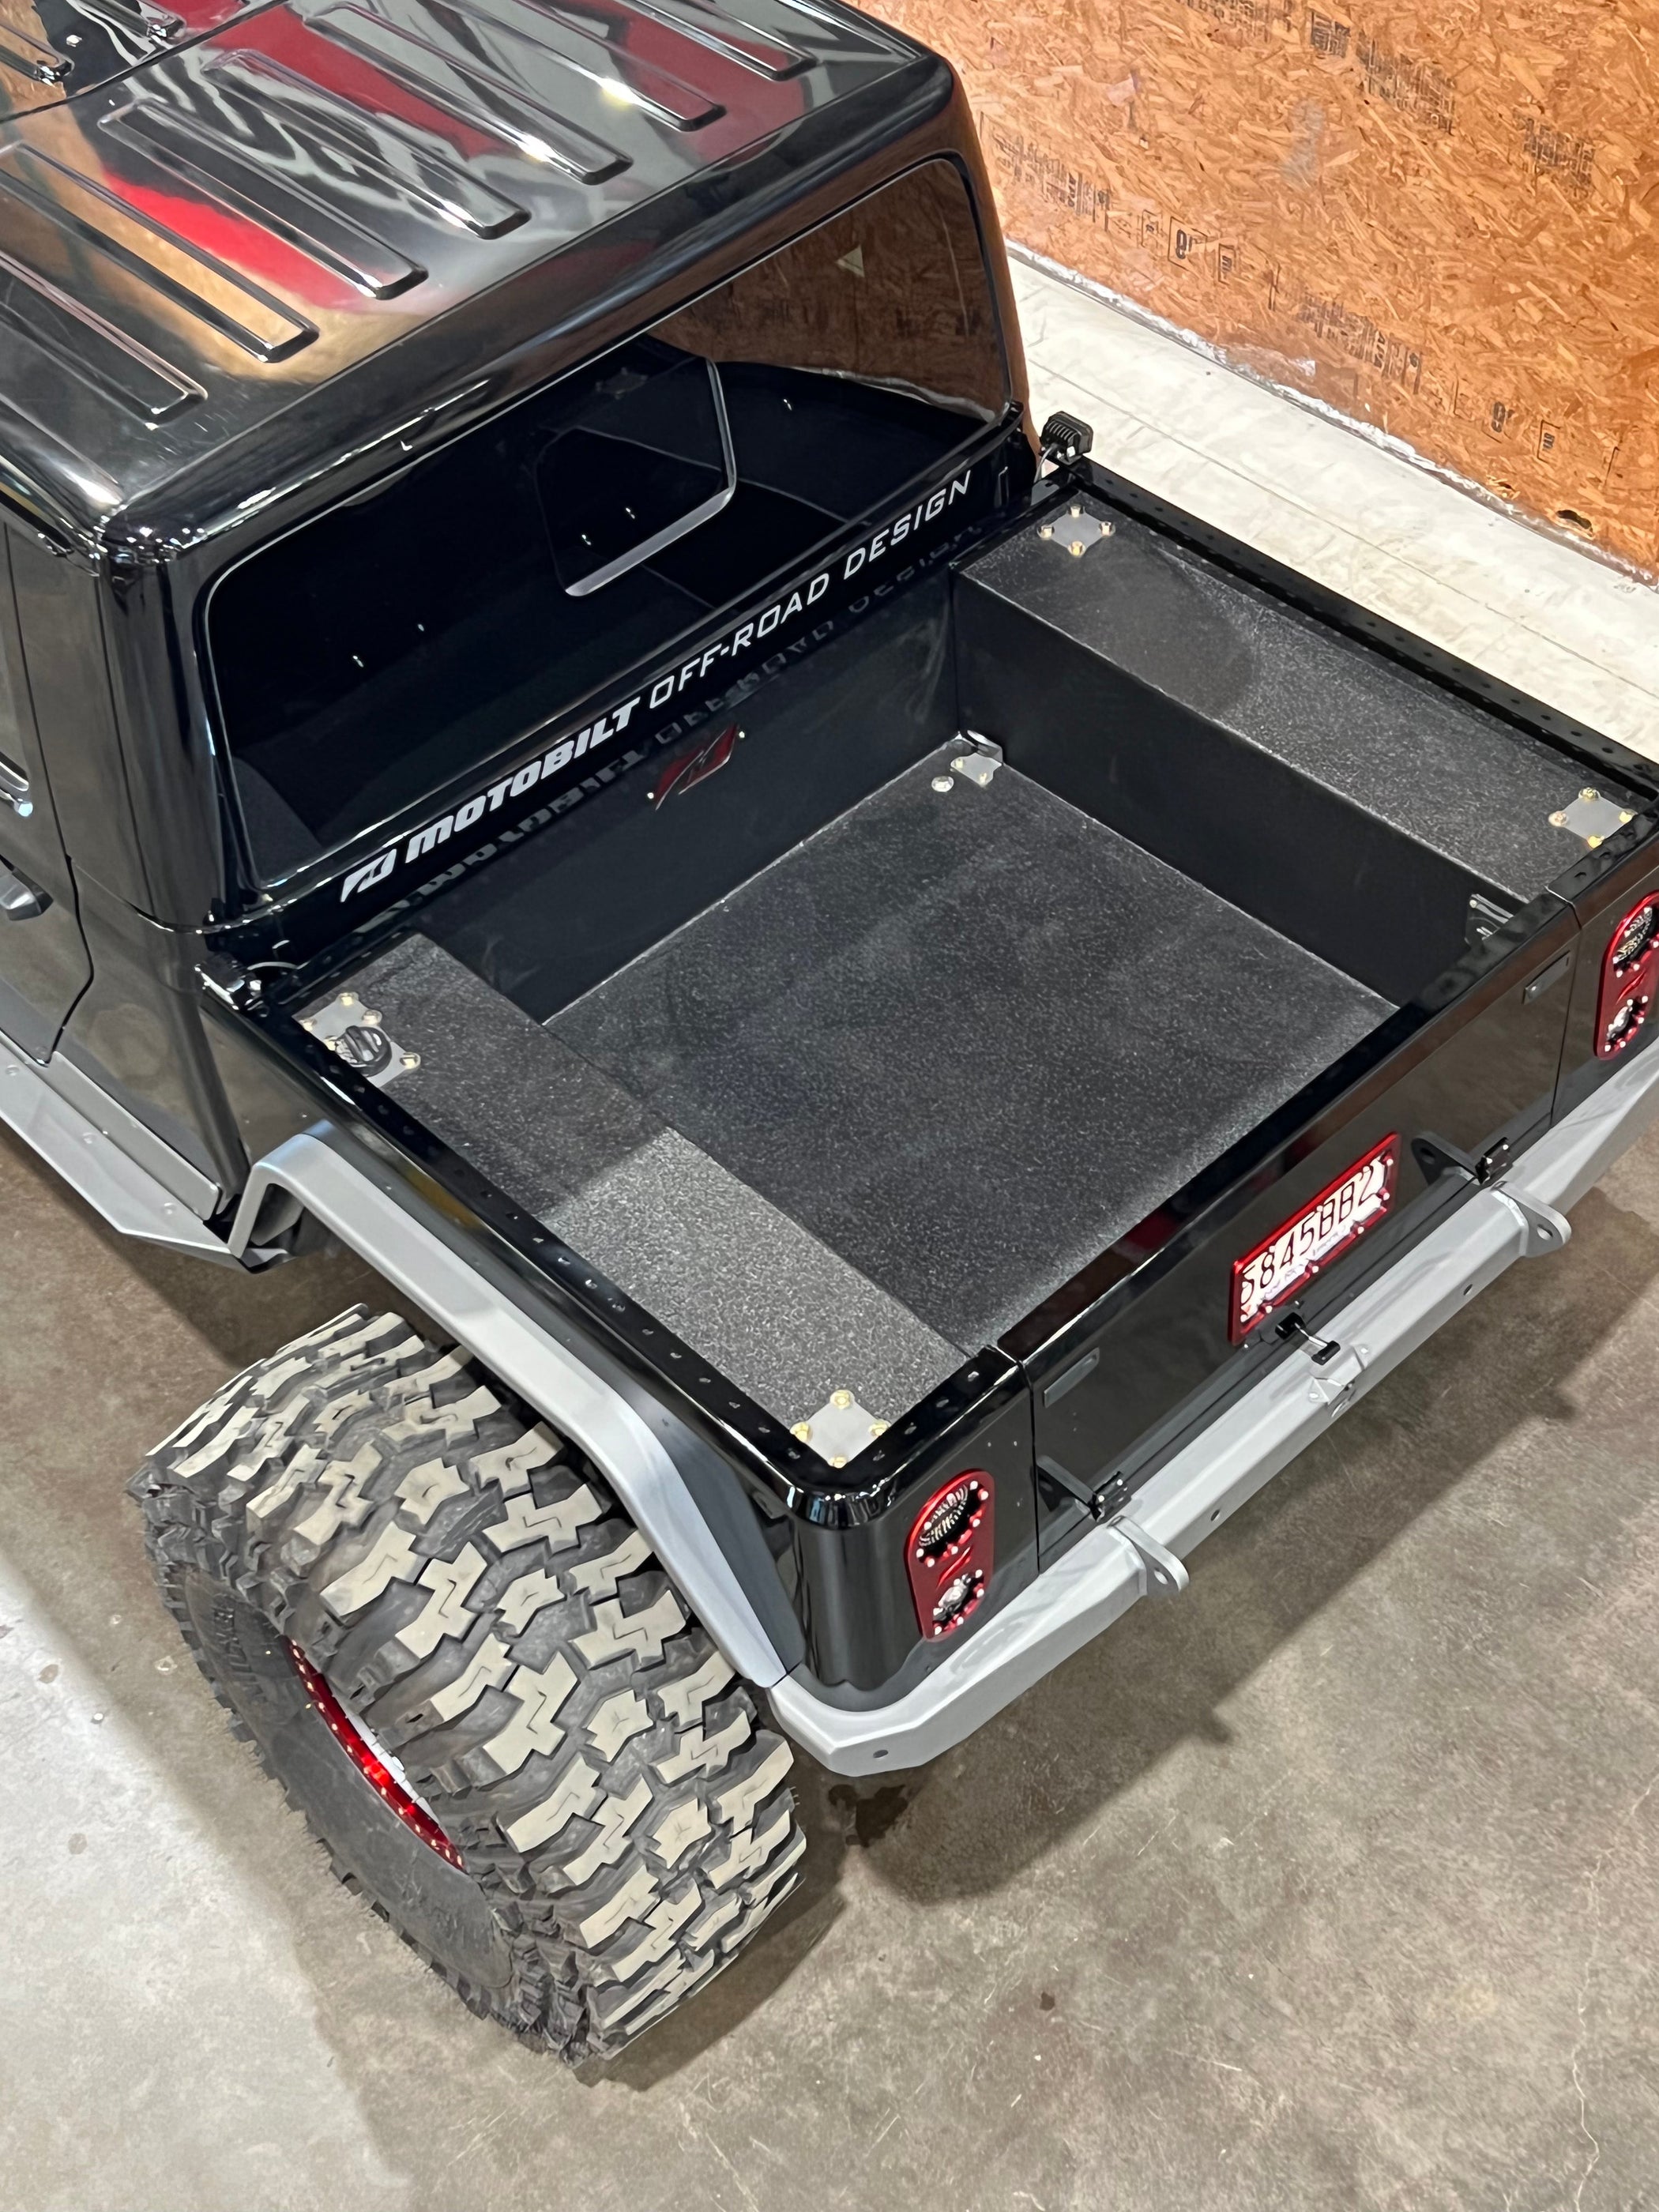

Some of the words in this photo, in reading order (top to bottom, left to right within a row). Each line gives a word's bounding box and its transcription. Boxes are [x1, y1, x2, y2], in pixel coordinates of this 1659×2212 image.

[405, 697, 640, 863] MOTOBILT
[649, 573, 830, 709] OFF-ROAD
[844, 470, 971, 580] DESIGN
